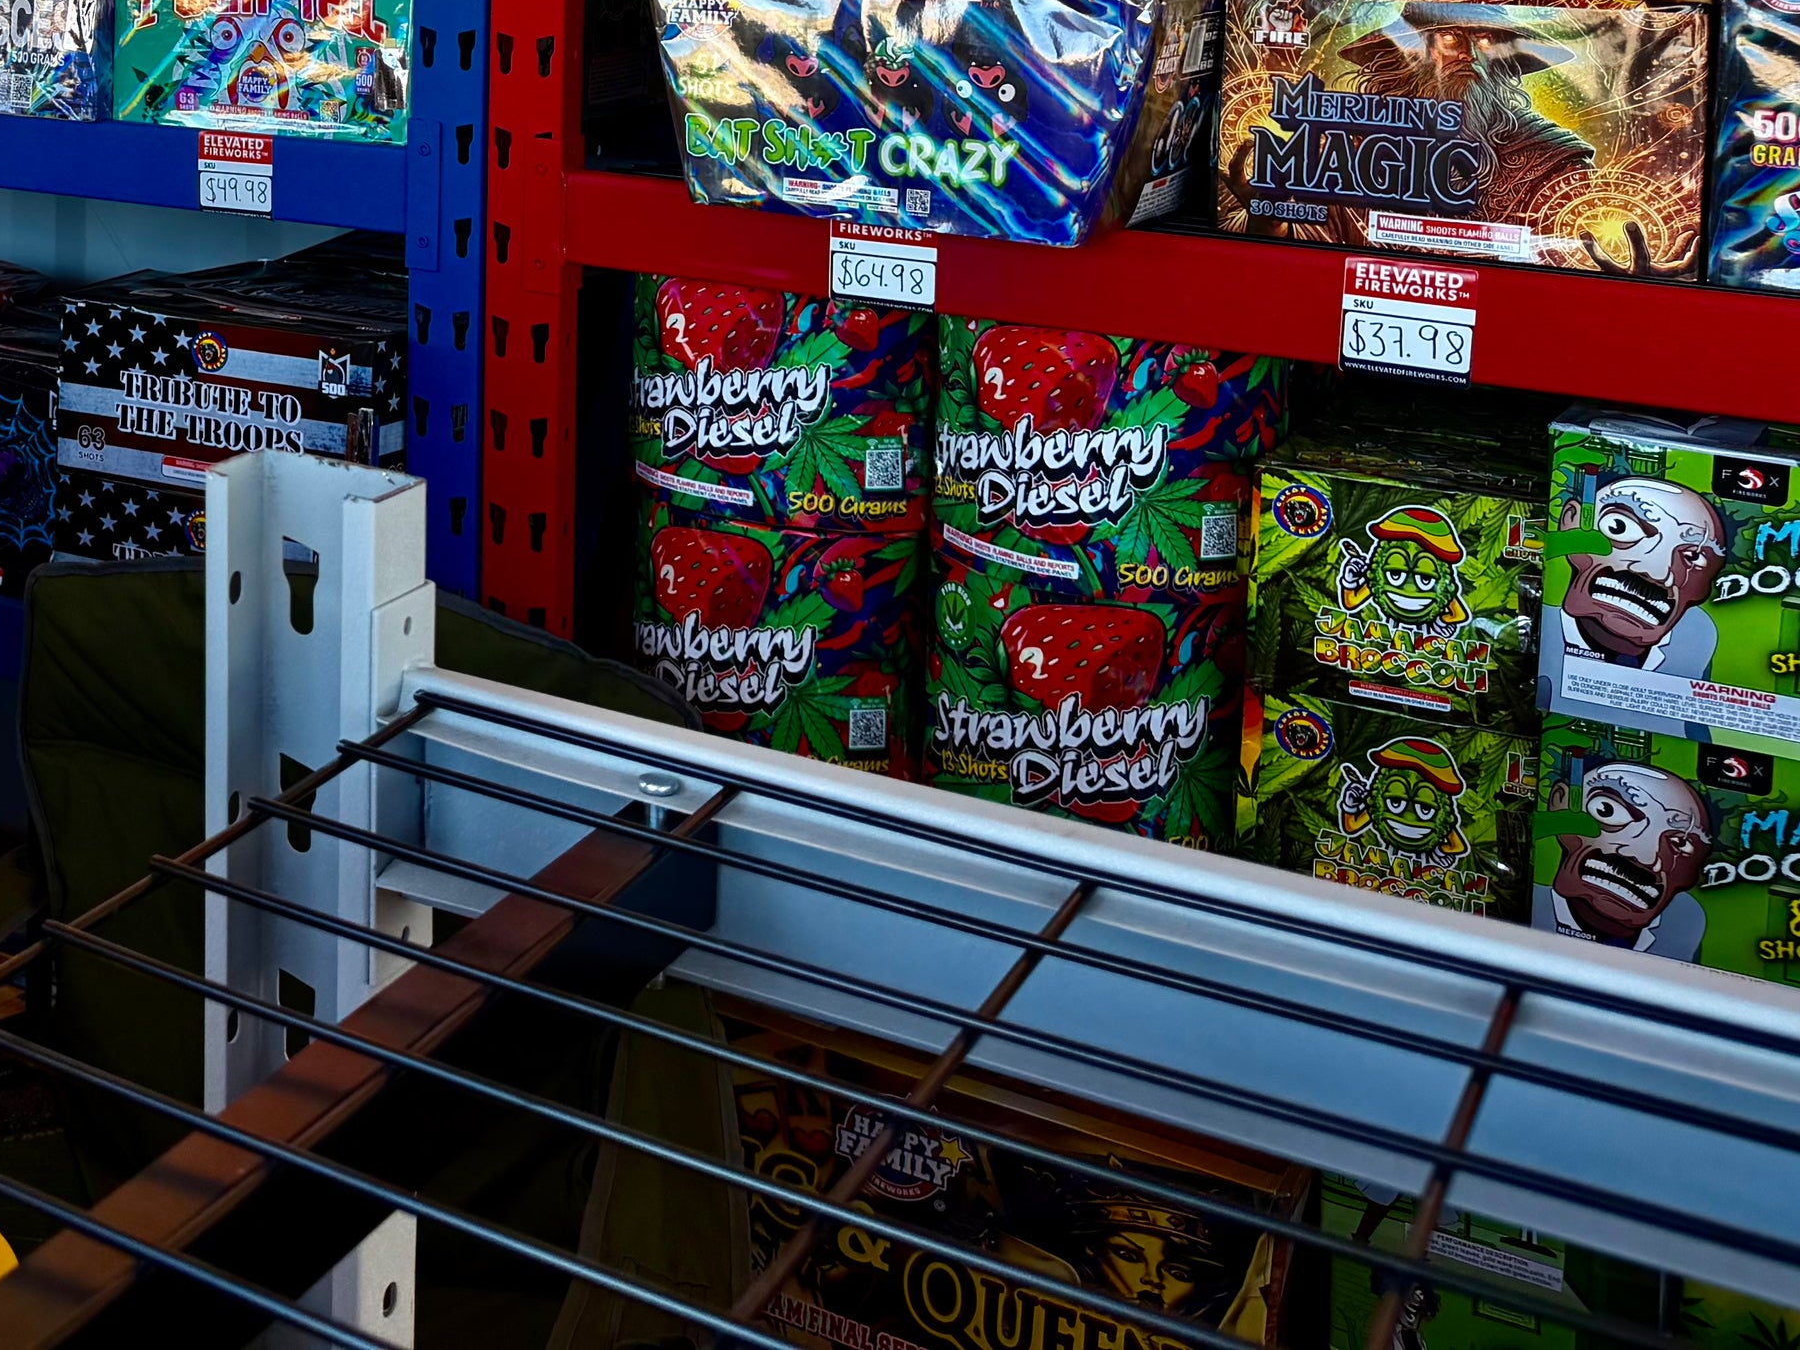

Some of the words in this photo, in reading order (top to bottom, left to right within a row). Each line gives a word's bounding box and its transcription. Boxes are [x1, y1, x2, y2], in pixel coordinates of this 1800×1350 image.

[1254, 29, 1309, 49] FIRE
[1272, 74, 1464, 132] MERLIN'S
[203, 136, 264, 151] ELEVATED
[685, 114, 758, 162] BAT
[762, 124, 875, 173] SH#T
[879, 134, 1020, 186] CRAZY
[1249, 127, 1481, 206] MAGIC
[206, 177, 267, 203] $49.98
[837, 256, 926, 296] $64.98
[1355, 262, 1464, 291] ELEVATED
[1353, 298, 1374, 310] SKU
[1347, 318, 1465, 366] $37.98
[119, 370, 251, 417] TRIBUTE
[258, 391, 301, 424] TO
[631, 354, 832, 424] trawberry
[77, 424, 107, 451] 63
[115, 403, 177, 440] THE
[184, 414, 304, 456] TROOPS
[663, 402, 801, 458] Diesel
[788, 491, 835, 514] 500
[840, 496, 908, 518] Grams
[1117, 564, 1169, 588] 500
[1174, 568, 1241, 590] Grams
[1315, 605, 1491, 665] JAMAICAN
[1313, 637, 1489, 694] BROCCOLI
[1690, 680, 1777, 705] WARNING
[933, 691, 1210, 762] Strawberry
